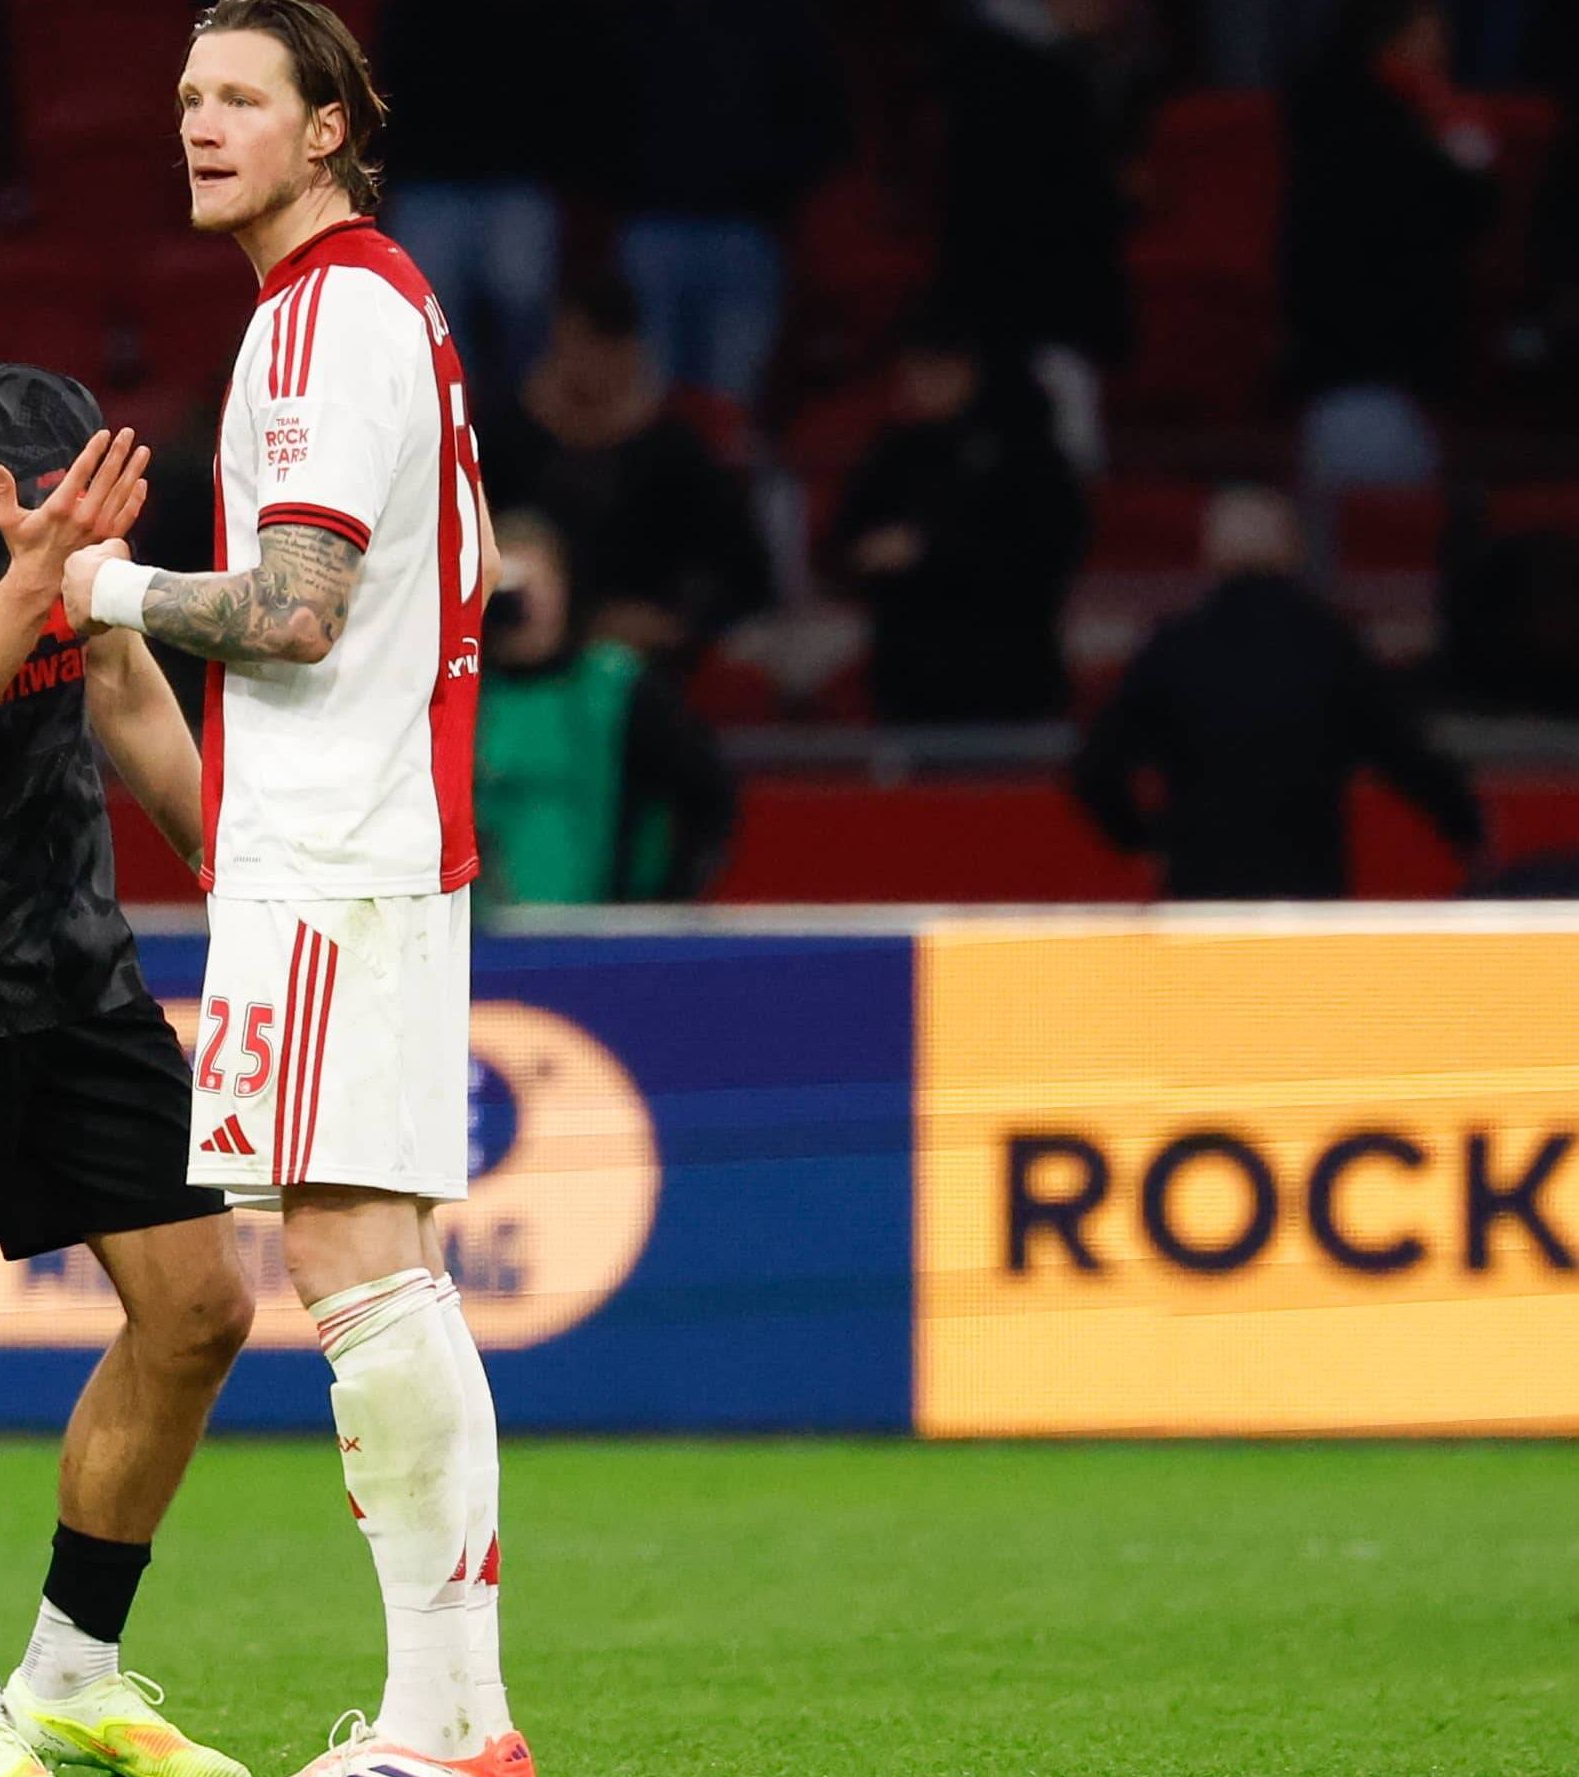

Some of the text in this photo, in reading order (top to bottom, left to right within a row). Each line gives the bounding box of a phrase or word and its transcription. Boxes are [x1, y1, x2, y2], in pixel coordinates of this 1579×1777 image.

[276, 417, 299, 426] TEAM
[265, 428, 309, 447] ROCK
[267, 447, 308, 466] SARS
[277, 467, 290, 483] IT
[195, 995, 274, 1097] 25
[1006, 1131, 1579, 1272] ROCK
